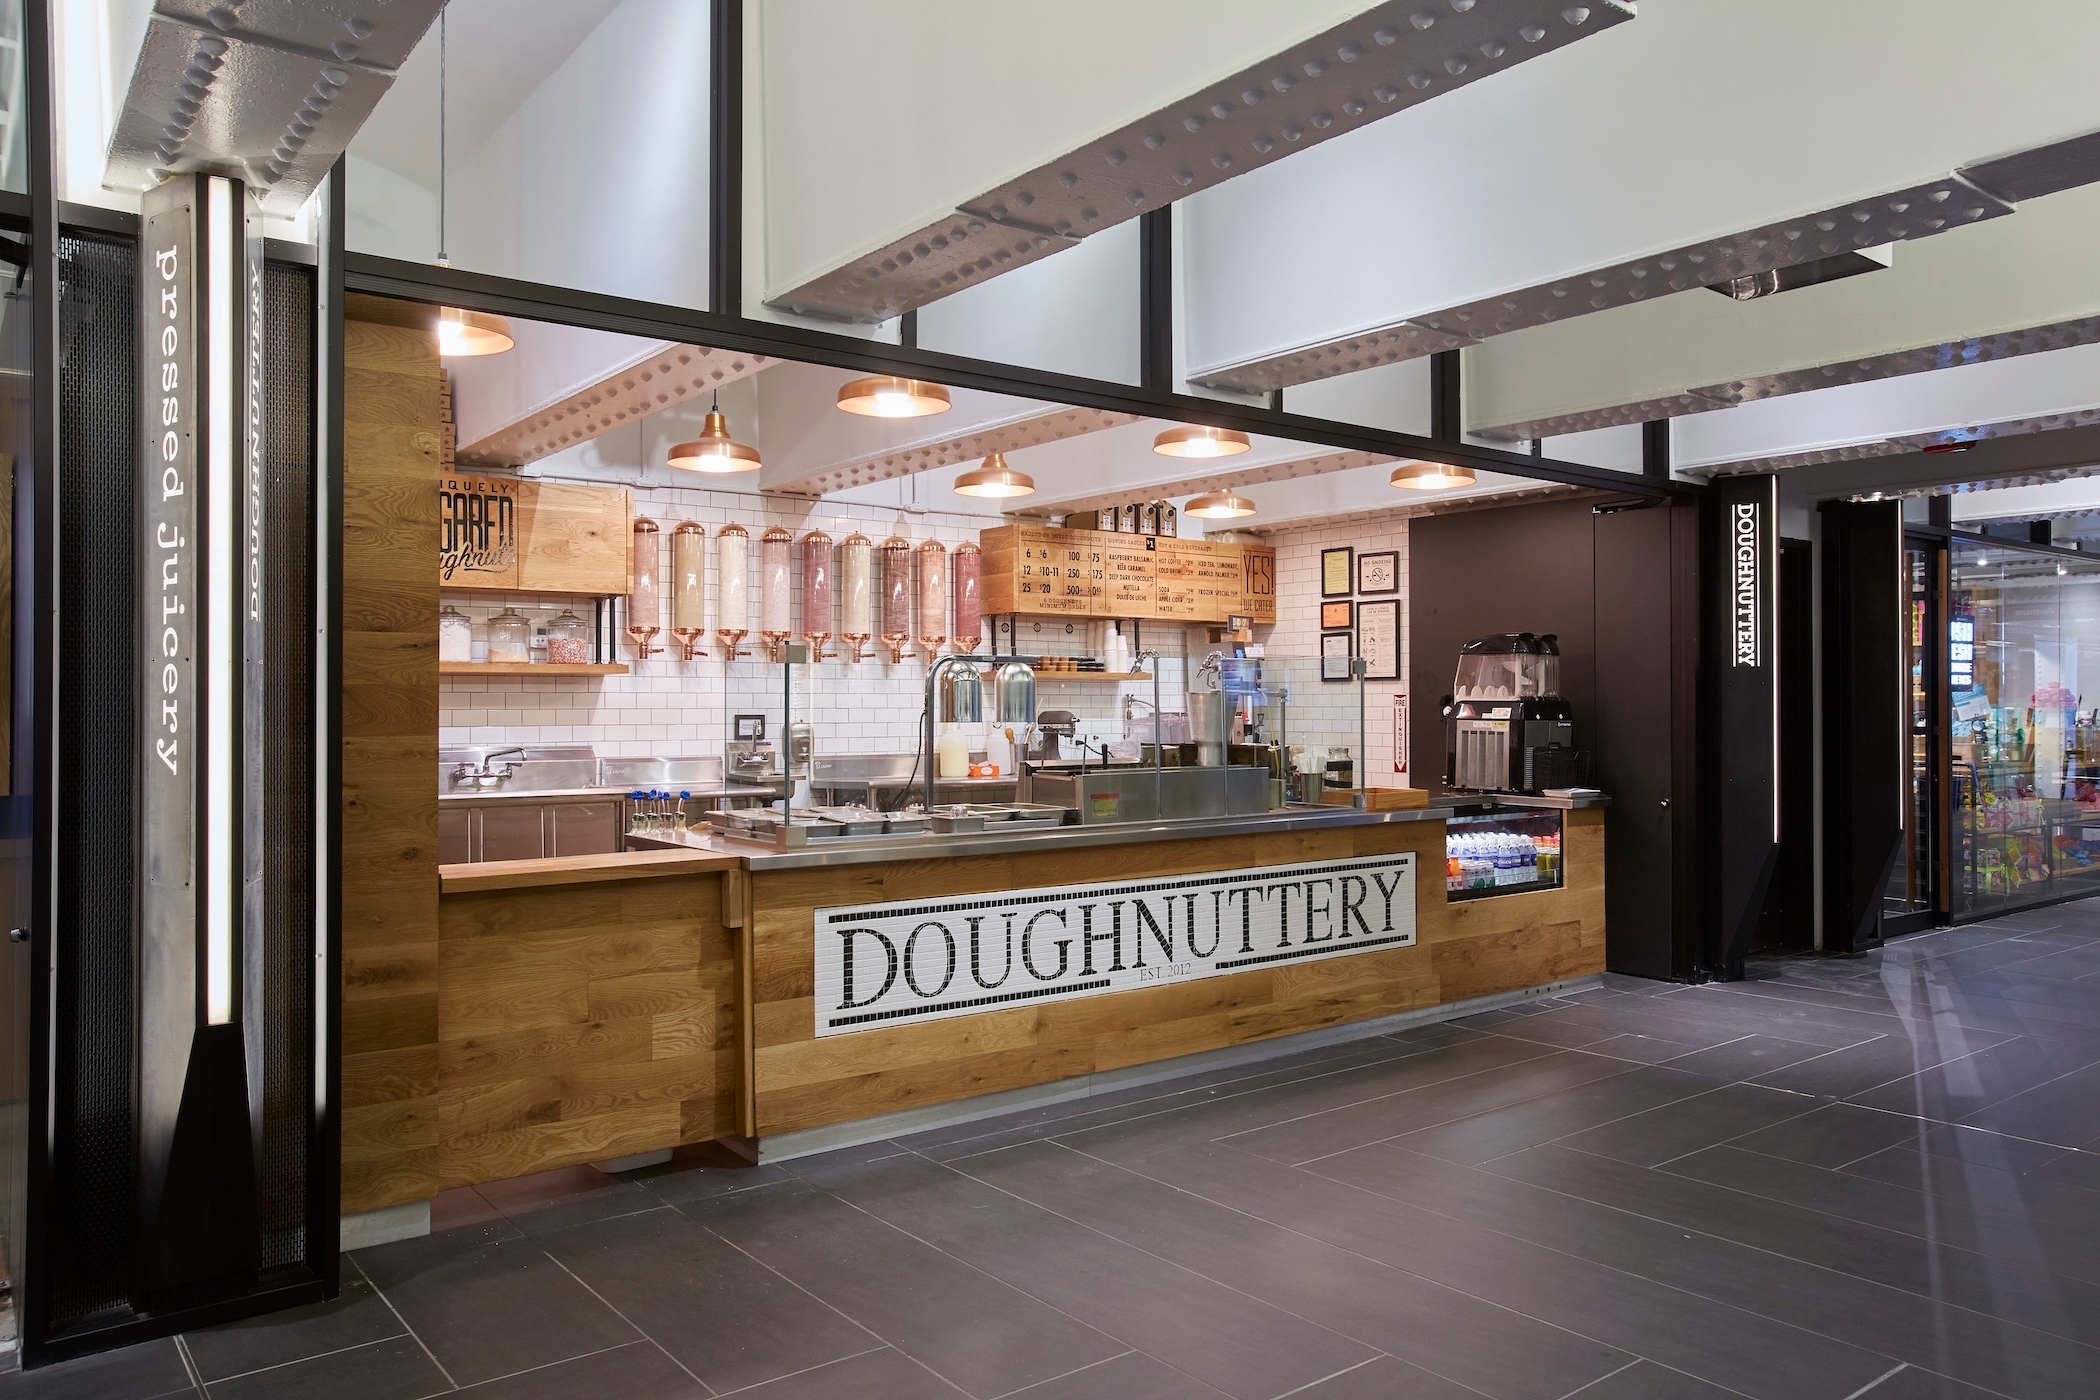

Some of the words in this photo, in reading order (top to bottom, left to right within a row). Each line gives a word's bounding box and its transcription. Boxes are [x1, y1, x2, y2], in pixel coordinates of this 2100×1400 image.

[156, 244, 184, 501] pressed
[250, 259, 262, 622] DOUGHNUTTERY
[1026, 549, 1030, 558] 6
[1040, 550, 1047, 558] $6
[1068, 552, 1080, 561] 100
[1023, 565, 1030, 575] 12
[1039, 567, 1059, 577] $10-11
[1068, 569, 1080, 578] 250
[1243, 555, 1274, 595] YES!
[1022, 583, 1030, 592] 25
[1039, 584, 1050, 593] $20
[1067, 586, 1082, 595] 500+
[1737, 503, 1754, 667] DOUGHNUTTERY
[1243, 599, 1253, 611] WE
[1254, 599, 1273, 612] CATER
[157, 524, 185, 775] juicery
[836, 870, 1404, 1010] DOUGHNUTTERY
[1140, 966, 1164, 981] EST.
[1168, 963, 1191, 977] 2012
